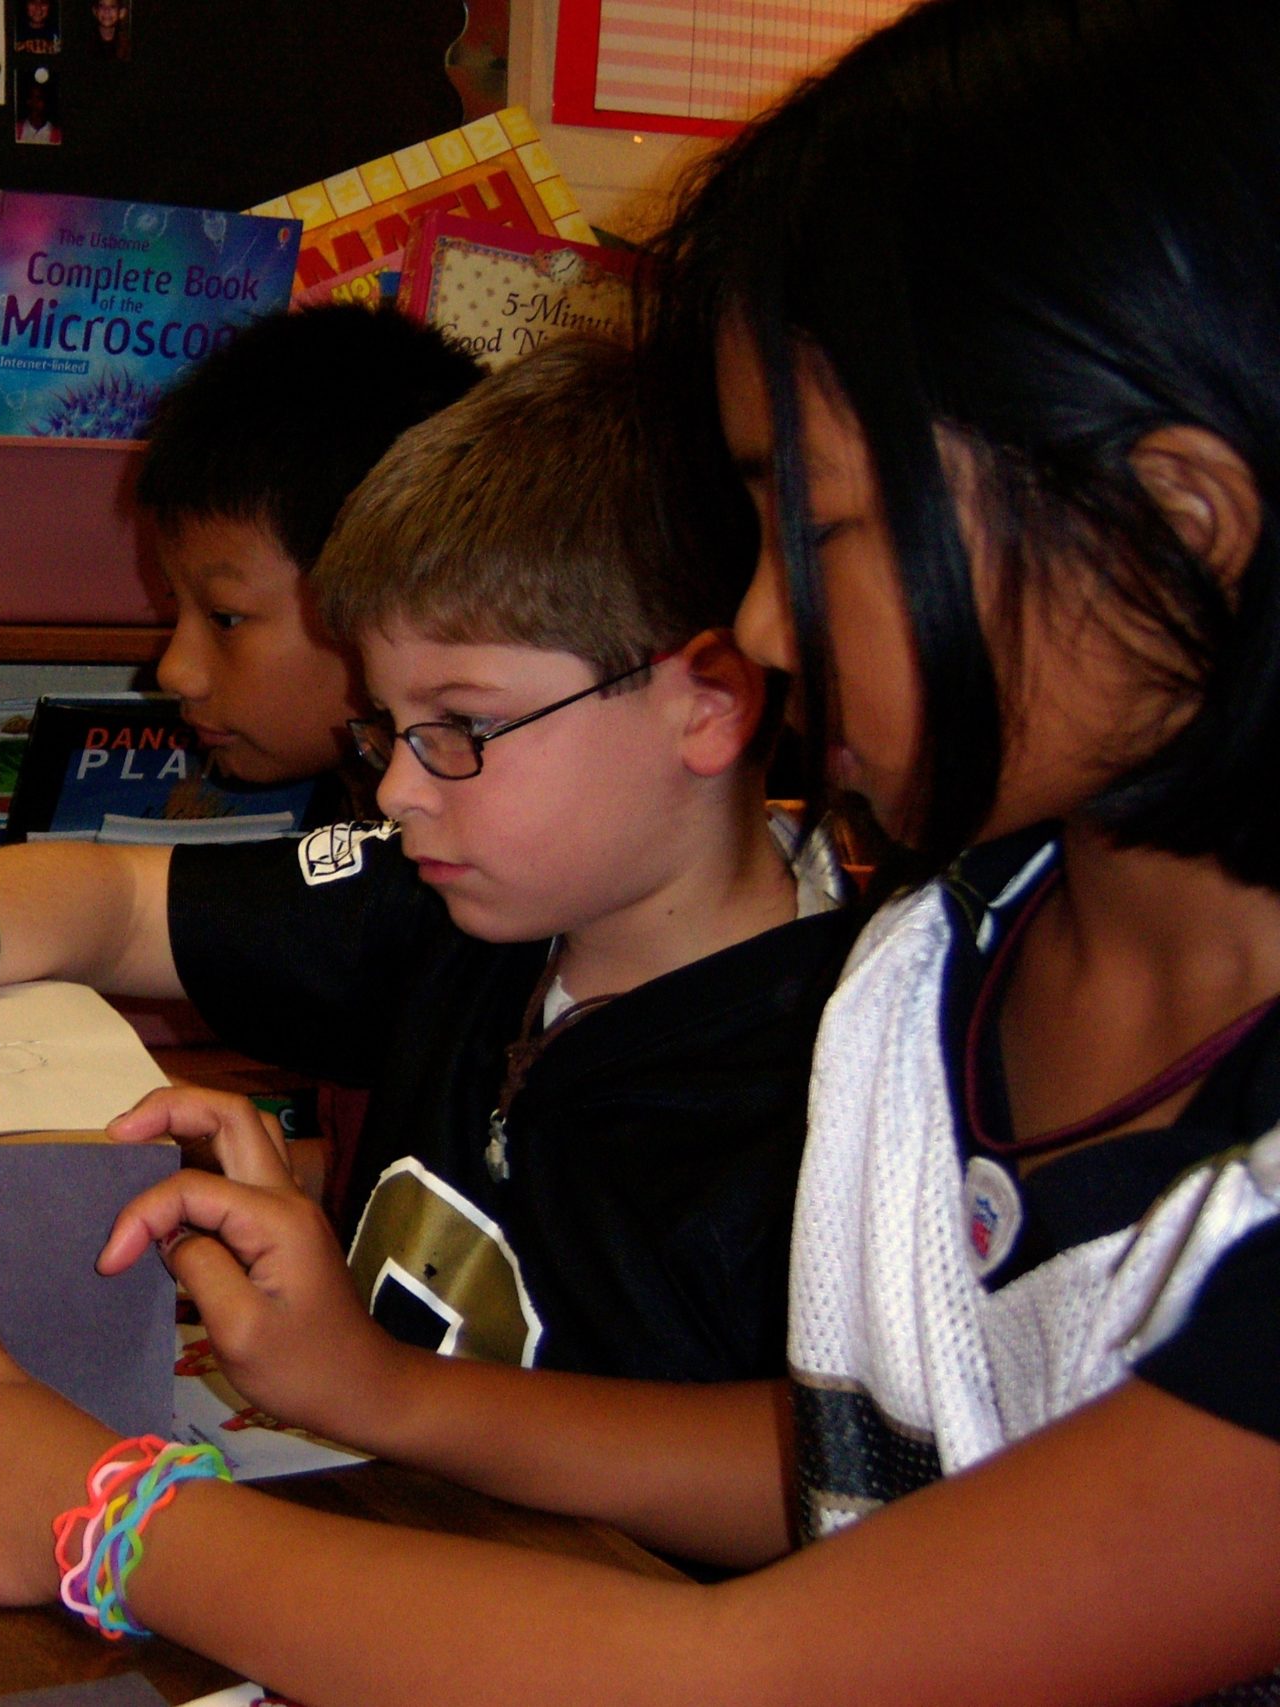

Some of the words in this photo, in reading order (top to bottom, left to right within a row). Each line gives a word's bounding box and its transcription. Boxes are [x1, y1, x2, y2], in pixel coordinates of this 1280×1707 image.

[59, 228, 84, 246] The
[90, 231, 150, 251] Usborne
[27, 251, 172, 304] Complete
[184, 265, 259, 301] Book
[99, 295, 116, 312] of
[121, 295, 143, 313] the
[76, 748, 216, 780] PLA
